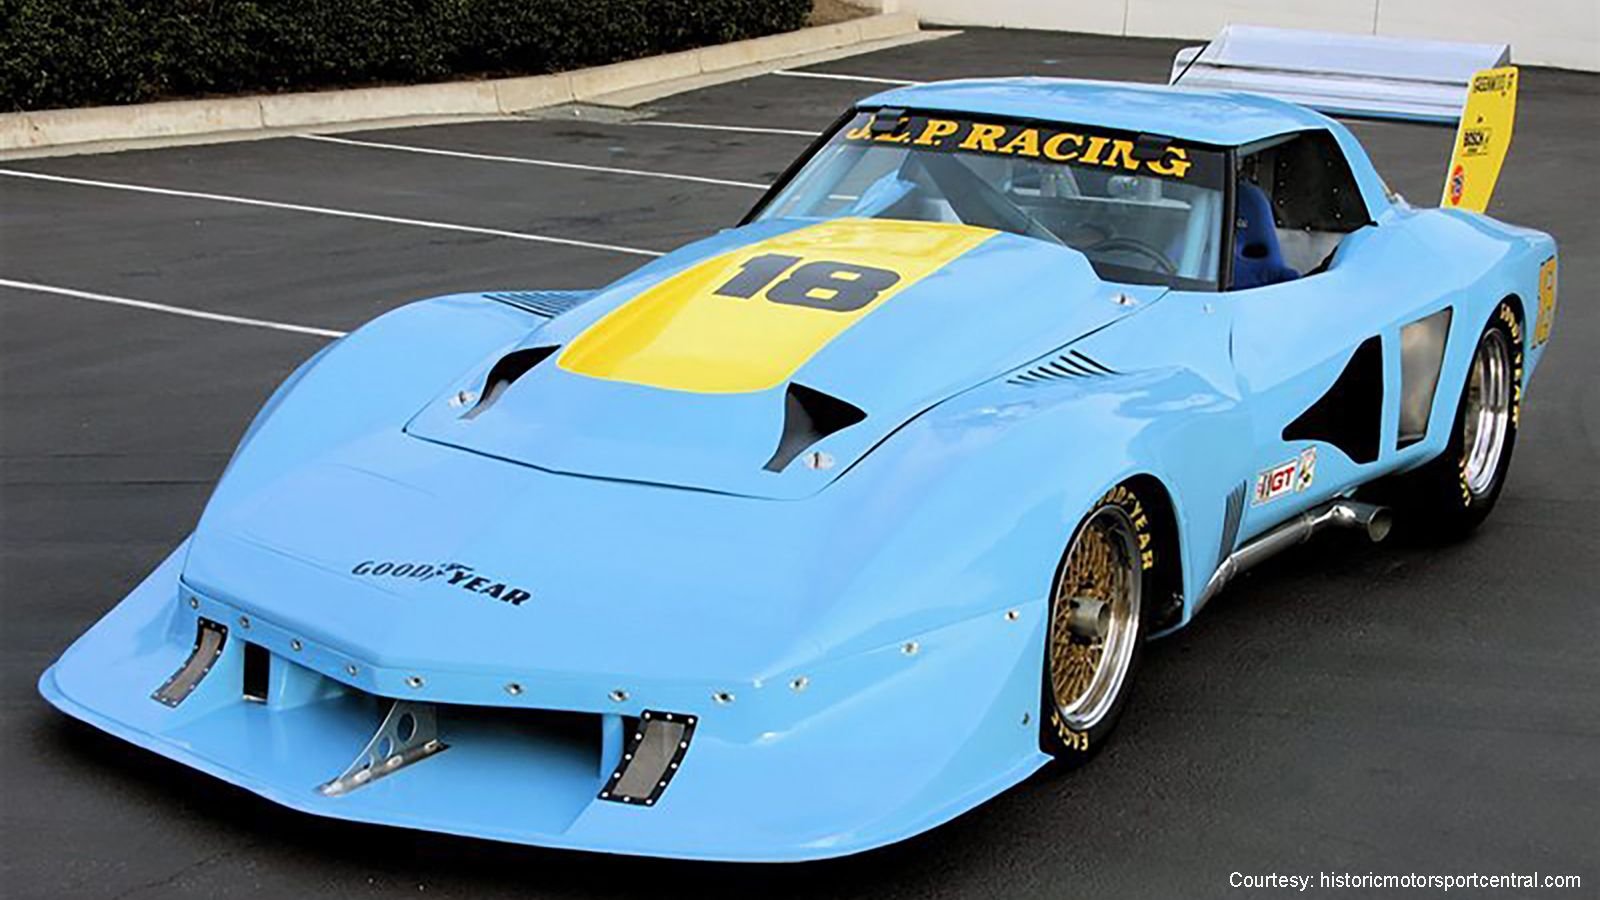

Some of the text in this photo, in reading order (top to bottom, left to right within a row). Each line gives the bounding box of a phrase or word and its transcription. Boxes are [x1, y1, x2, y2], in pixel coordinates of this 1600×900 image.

[959, 123, 1191, 177] RACING
[712, 253, 901, 312] 18
[1271, 466, 1295, 492] GT
[352, 561, 532, 606] GOODYEAR
